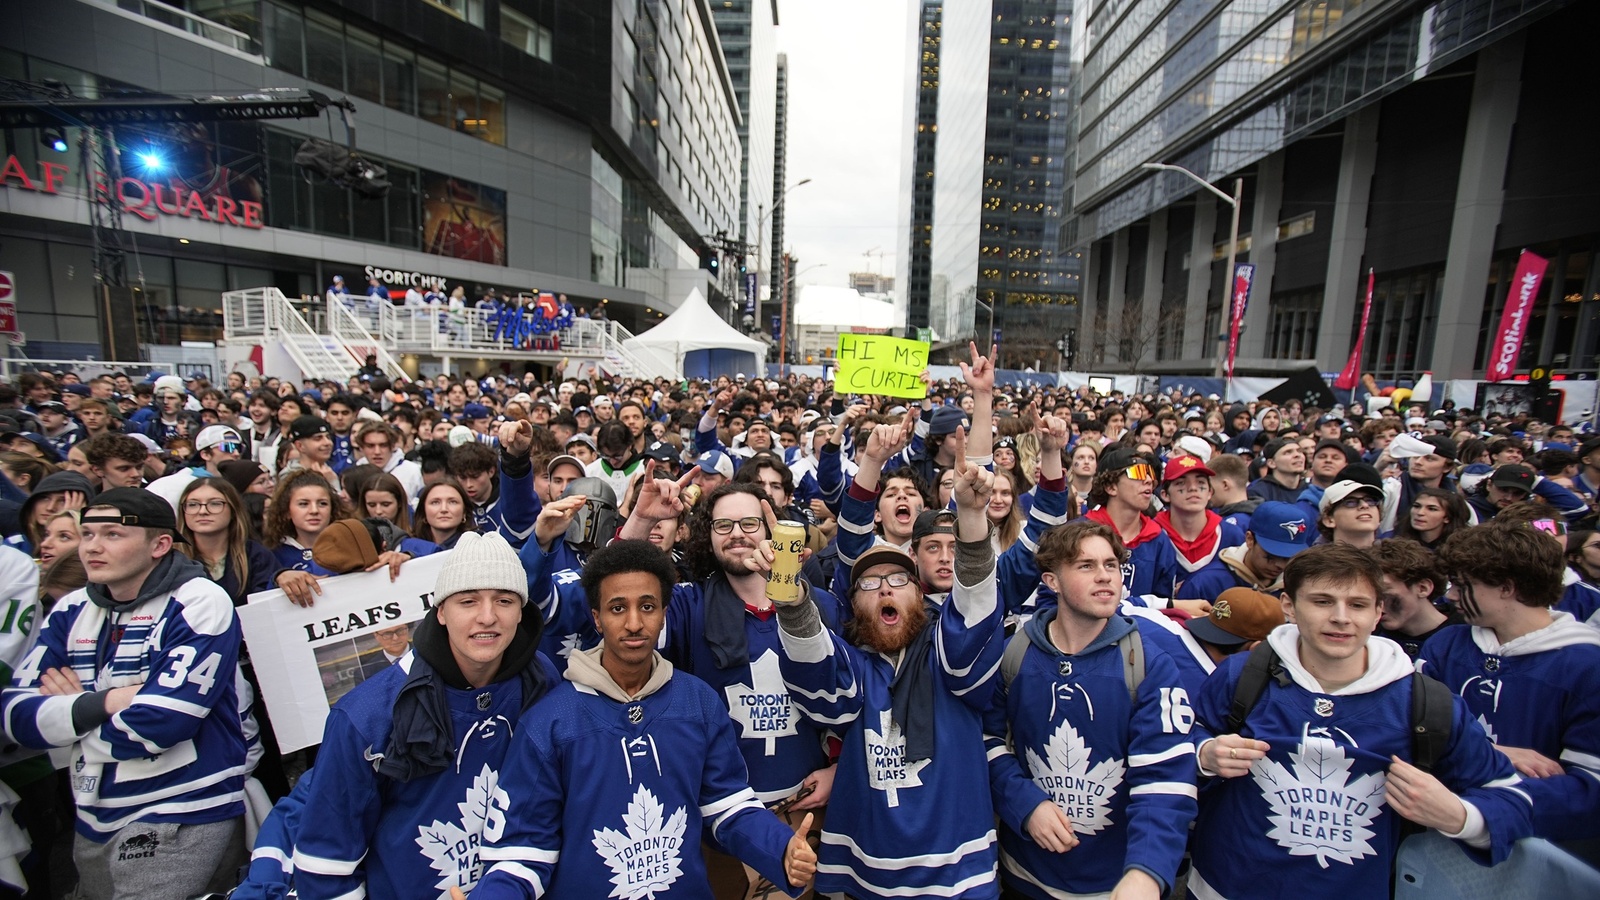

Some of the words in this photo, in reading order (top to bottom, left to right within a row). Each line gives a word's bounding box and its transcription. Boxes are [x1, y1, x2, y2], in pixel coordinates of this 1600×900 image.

[841, 337, 876, 360] HI
[850, 366, 920, 390] CURTI
[303, 601, 402, 643] LEAFS
[419, 590, 435, 612] I
[157, 645, 222, 695] 34
[749, 706, 791, 719] MAPLE
[1159, 687, 1195, 735] 16
[753, 718, 788, 731] LEAFS
[875, 757, 906, 768] MPLE
[877, 769, 906, 781] LAFS
[1038, 775, 1105, 797] TORONTO
[1048, 789, 1094, 806] MAPLE
[1274, 787, 1369, 816] TORONTO
[1290, 805, 1353, 827] MAPLE
[1290, 821, 1353, 842] LEAFS
[118, 851, 155, 861] Roots
[614, 836, 677, 863] TORONTO
[626, 850, 669, 871] MAPLE
[627, 863, 670, 884] LEAFS
